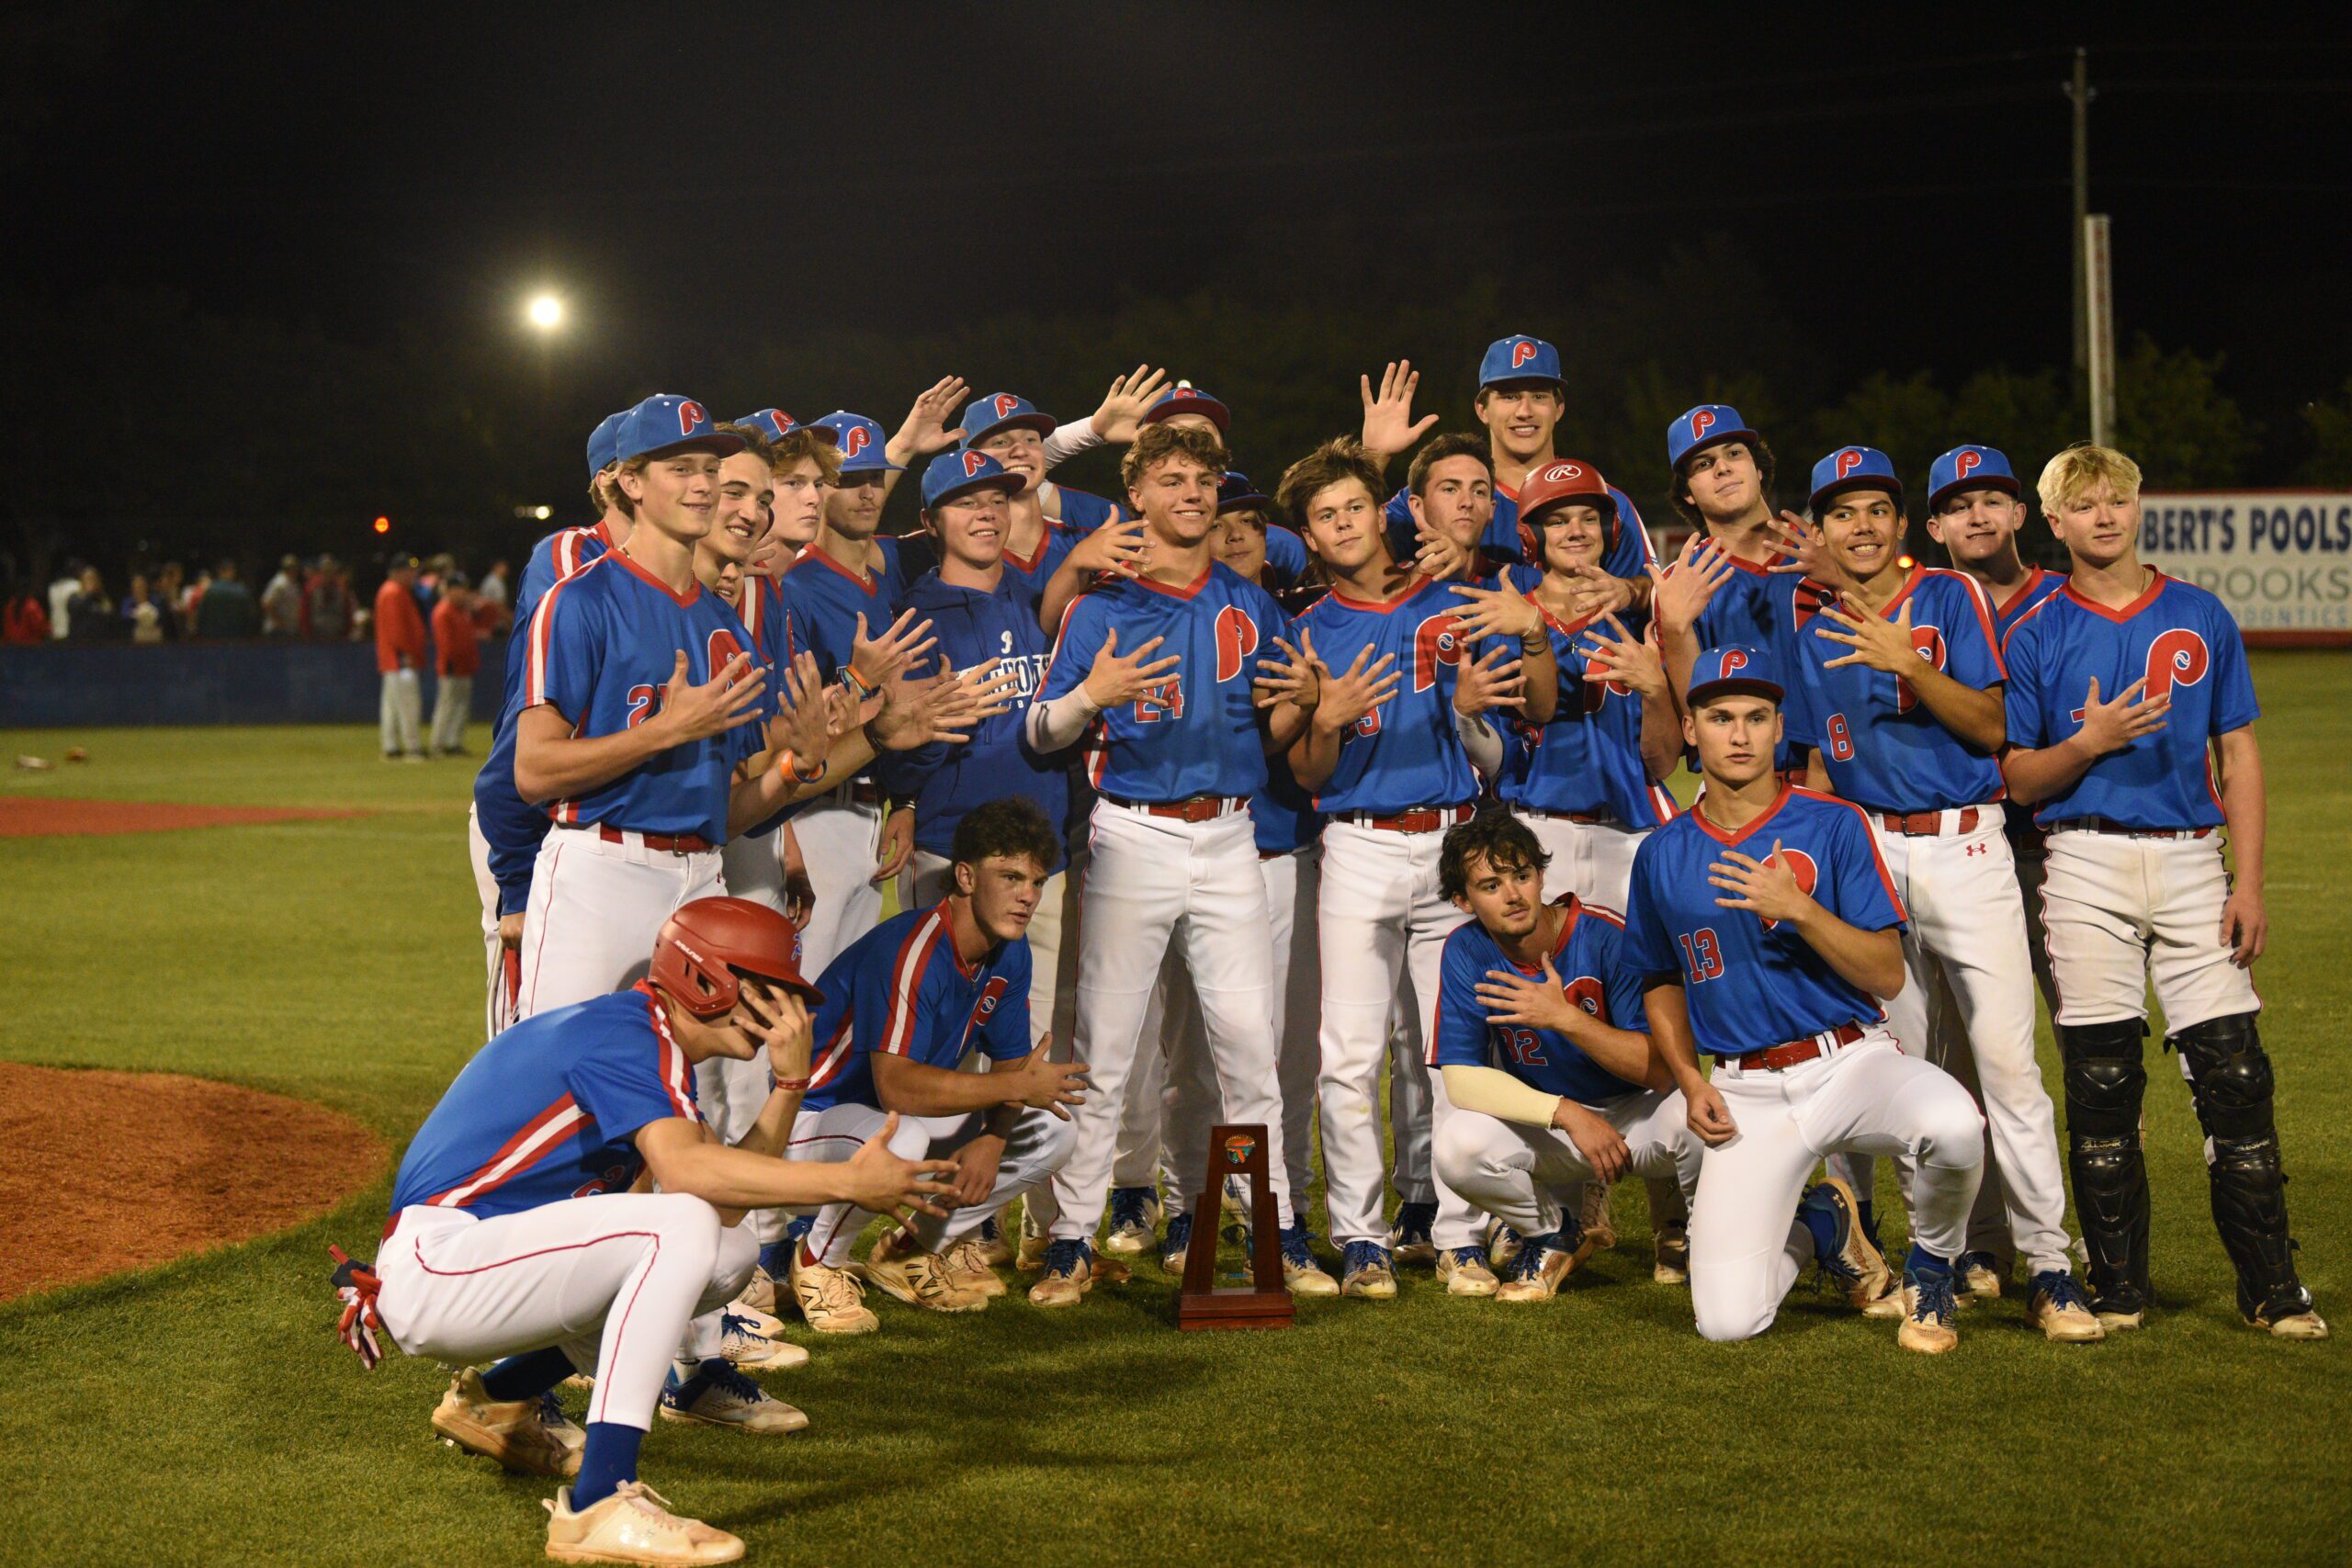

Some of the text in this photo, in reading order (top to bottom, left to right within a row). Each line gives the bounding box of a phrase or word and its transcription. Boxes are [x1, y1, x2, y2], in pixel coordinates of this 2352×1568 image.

[1512, 341, 1538, 369] P
[678, 400, 705, 436] P
[770, 410, 795, 435] P
[994, 394, 1019, 420] P
[846, 425, 872, 458] P
[1691, 410, 1716, 442] P
[962, 450, 987, 478] P
[1836, 450, 1862, 480] P
[1955, 450, 1982, 480] P
[2143, 506, 2352, 553] BERT'S POOLS
[1215, 604, 1259, 683] P
[1414, 614, 1471, 694] P
[1720, 649, 1748, 679] P
[2143, 628, 2209, 714] P
[1134, 672, 1185, 723] 24
[1826, 713, 1855, 761] 8
[1679, 926, 1724, 984] 13
